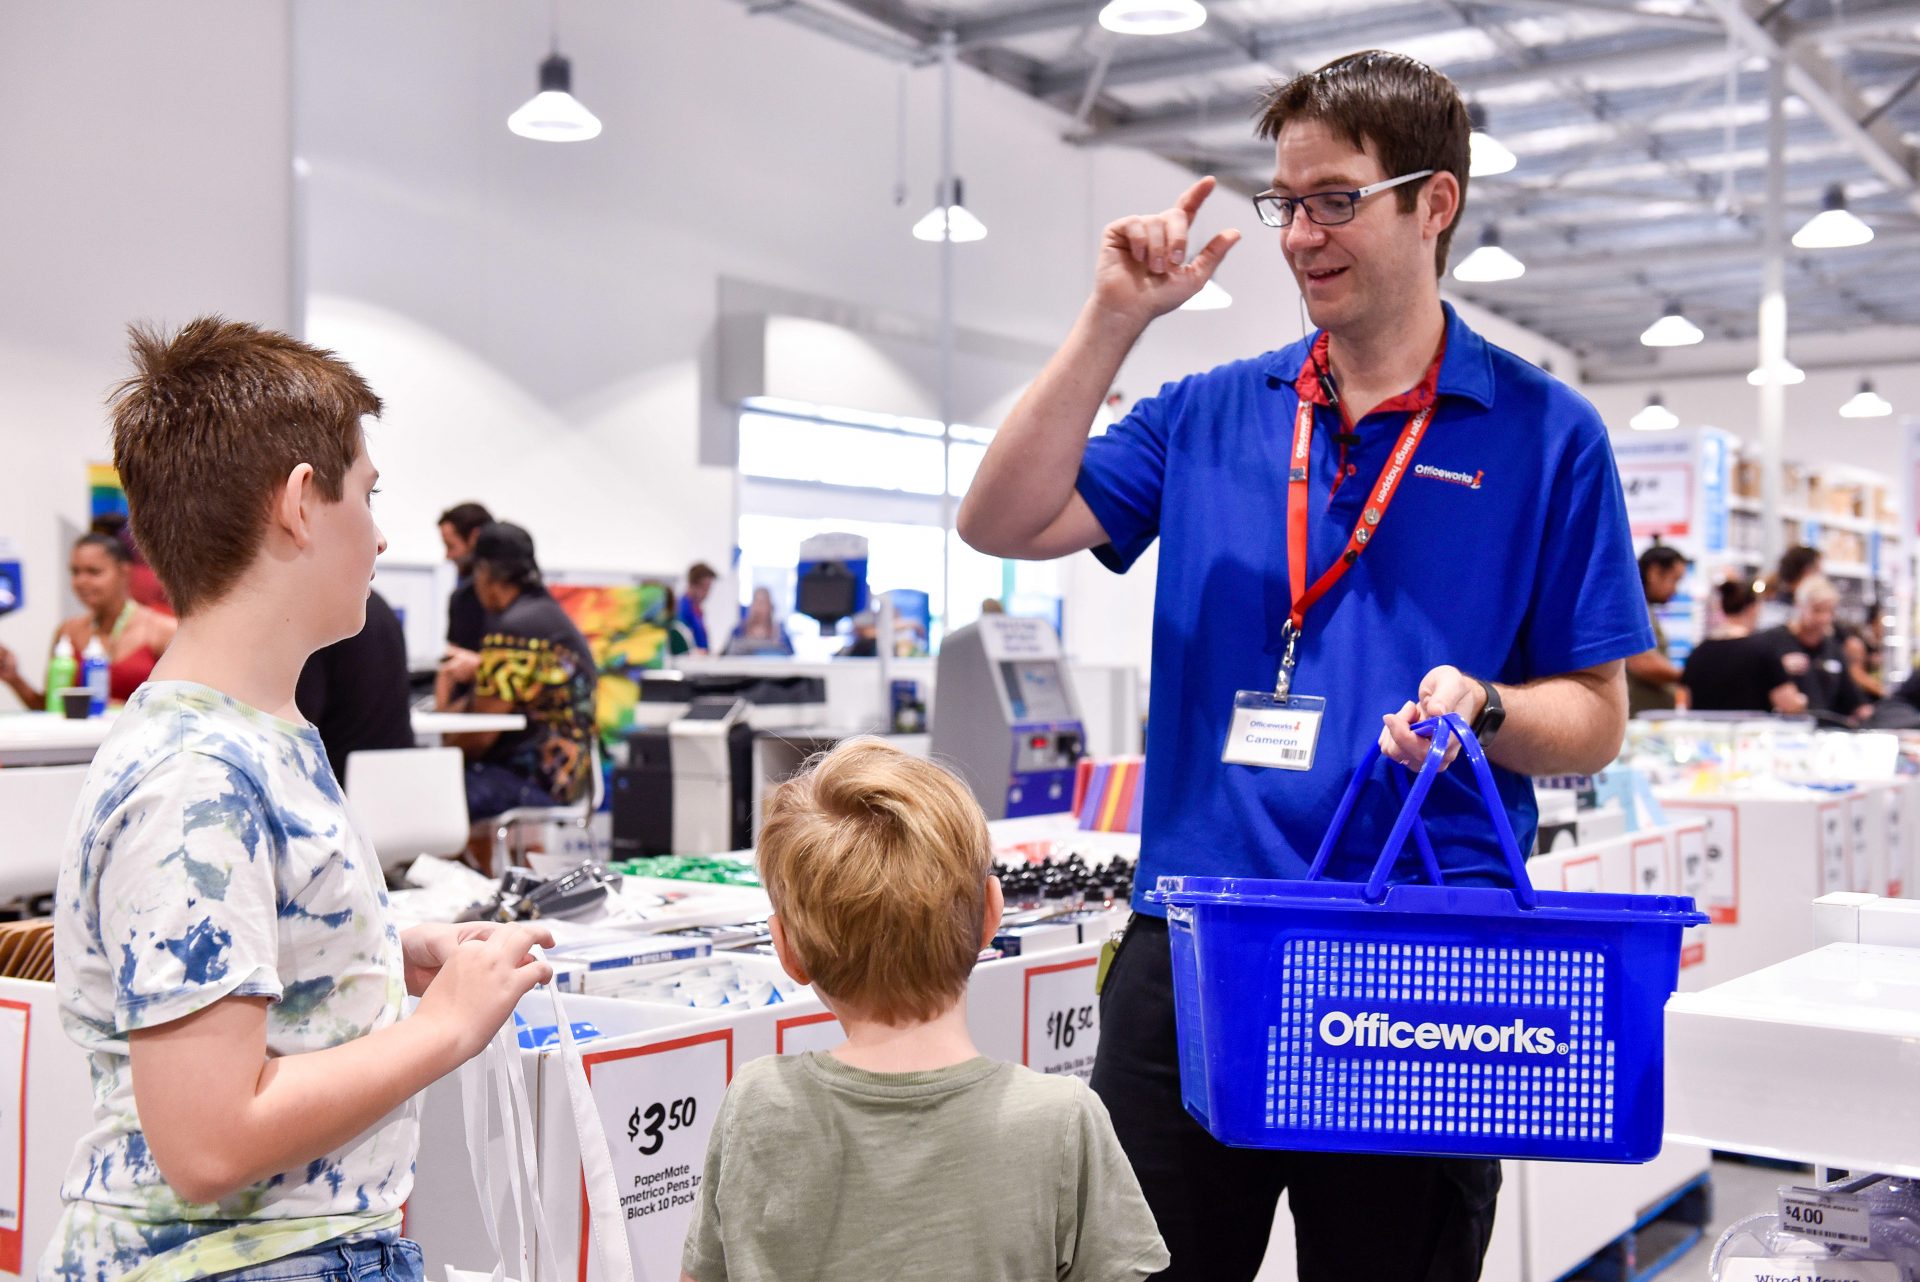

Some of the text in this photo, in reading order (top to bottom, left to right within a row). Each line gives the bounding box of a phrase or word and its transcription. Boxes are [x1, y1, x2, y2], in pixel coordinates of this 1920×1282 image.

[1395, 434, 1416, 467] things
[1376, 463, 1402, 504] happen
[1414, 464, 1474, 484] Officeworks
[1249, 720, 1292, 731] Officeworks
[1246, 734, 1298, 747] Cameron
[634, 1164, 690, 1188] PaperMate
[667, 1179, 690, 1194] Pens
[627, 1191, 696, 1220] Black 10 Pack
[1785, 1205, 1824, 1225] $4.00
